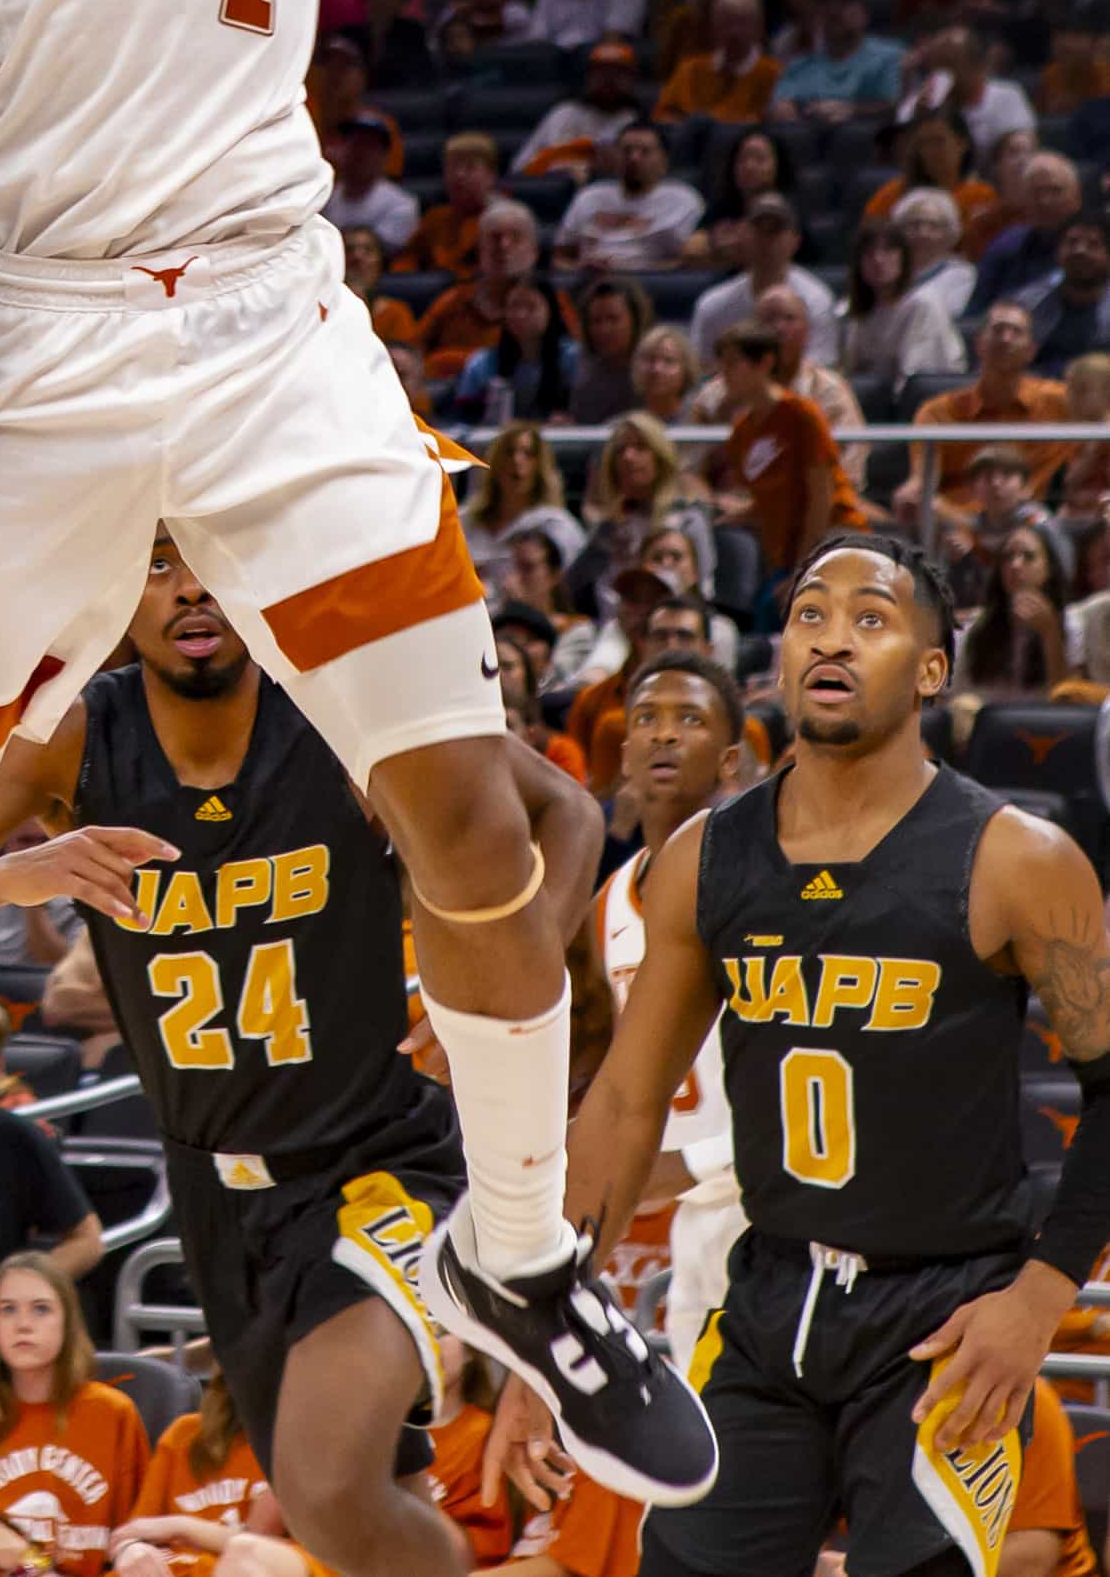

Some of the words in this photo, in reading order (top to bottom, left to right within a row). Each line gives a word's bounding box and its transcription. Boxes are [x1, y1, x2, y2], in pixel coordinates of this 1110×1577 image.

[147, 937, 314, 1070] 24
[722, 955, 941, 1031] UAPB
[780, 1047, 856, 1189] 0
